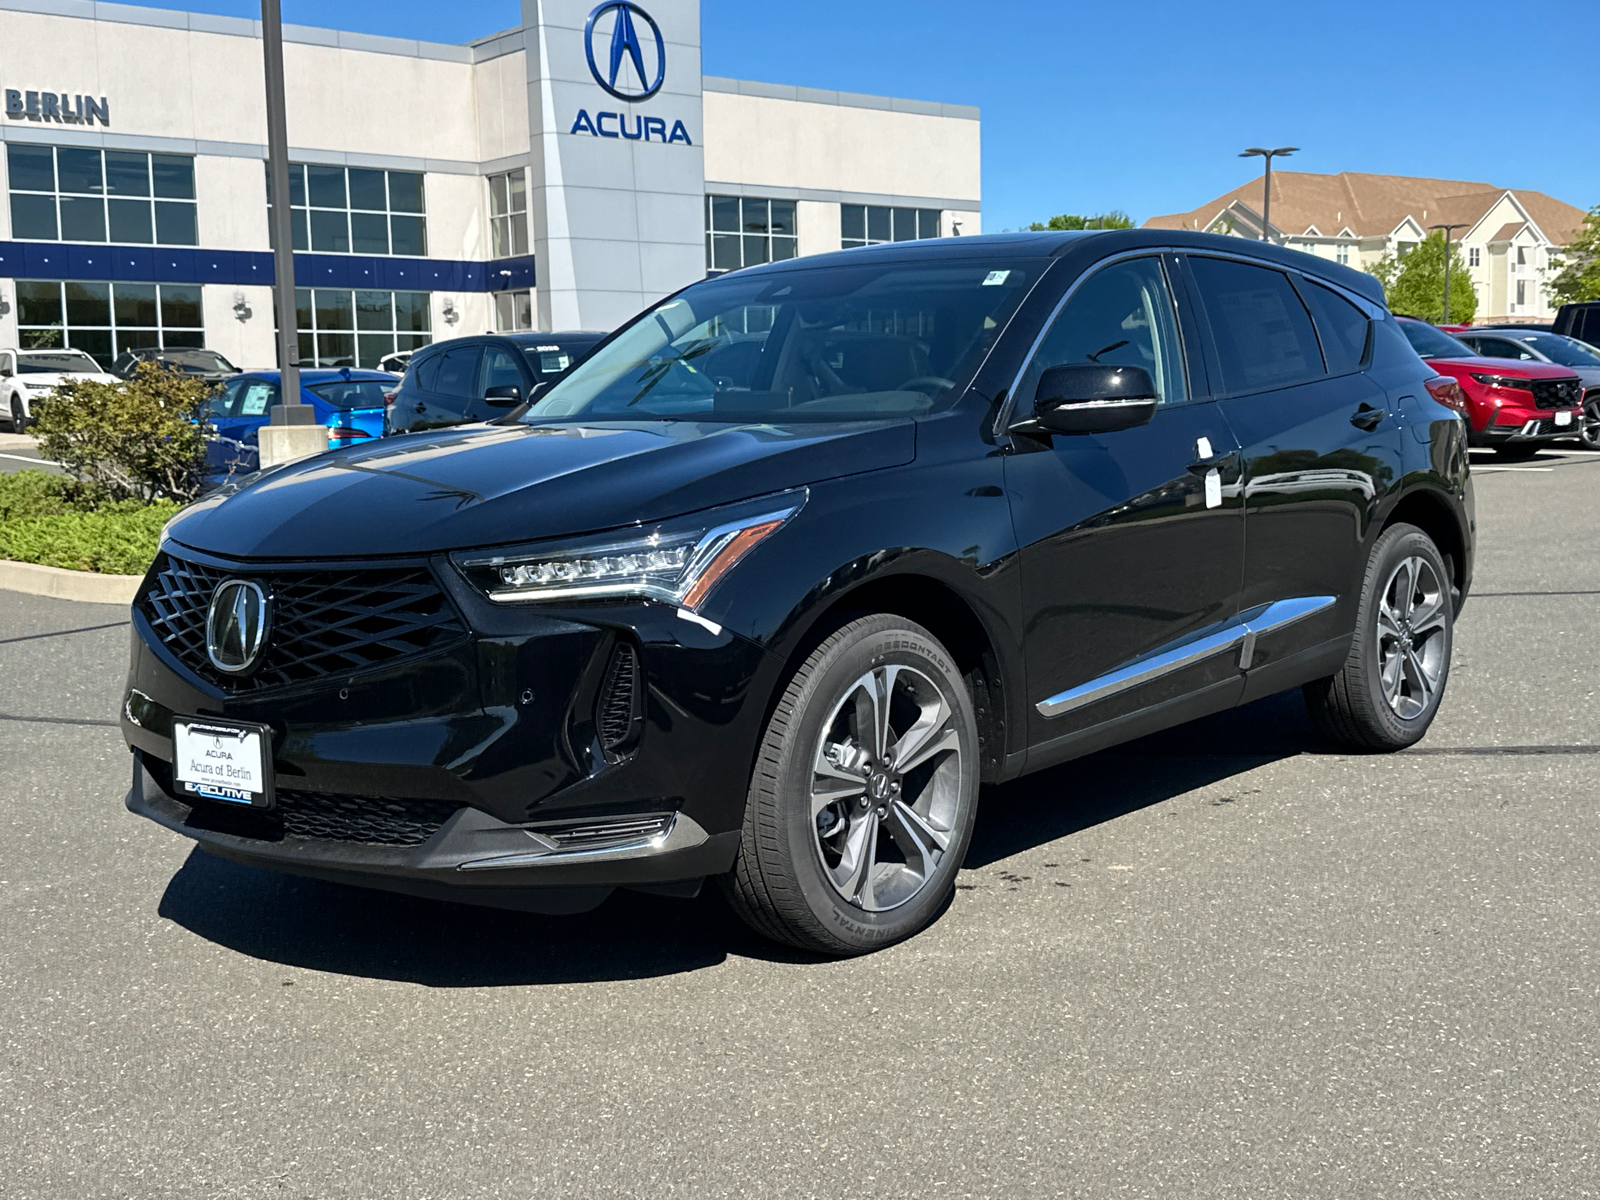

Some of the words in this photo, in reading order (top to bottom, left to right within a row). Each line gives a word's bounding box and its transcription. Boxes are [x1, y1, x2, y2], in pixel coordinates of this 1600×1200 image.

[5, 88, 109, 124] BERLIN
[570, 108, 692, 145] ACURA
[866, 640, 952, 674] OSSCONTACT
[190, 759, 213, 774] Acura
[215, 765, 223, 776] of
[226, 764, 251, 780] Berlin
[205, 749, 233, 760] ACURA
[185, 782, 252, 801] EXECUTIVE
[832, 907, 921, 939] NTINENTAL
